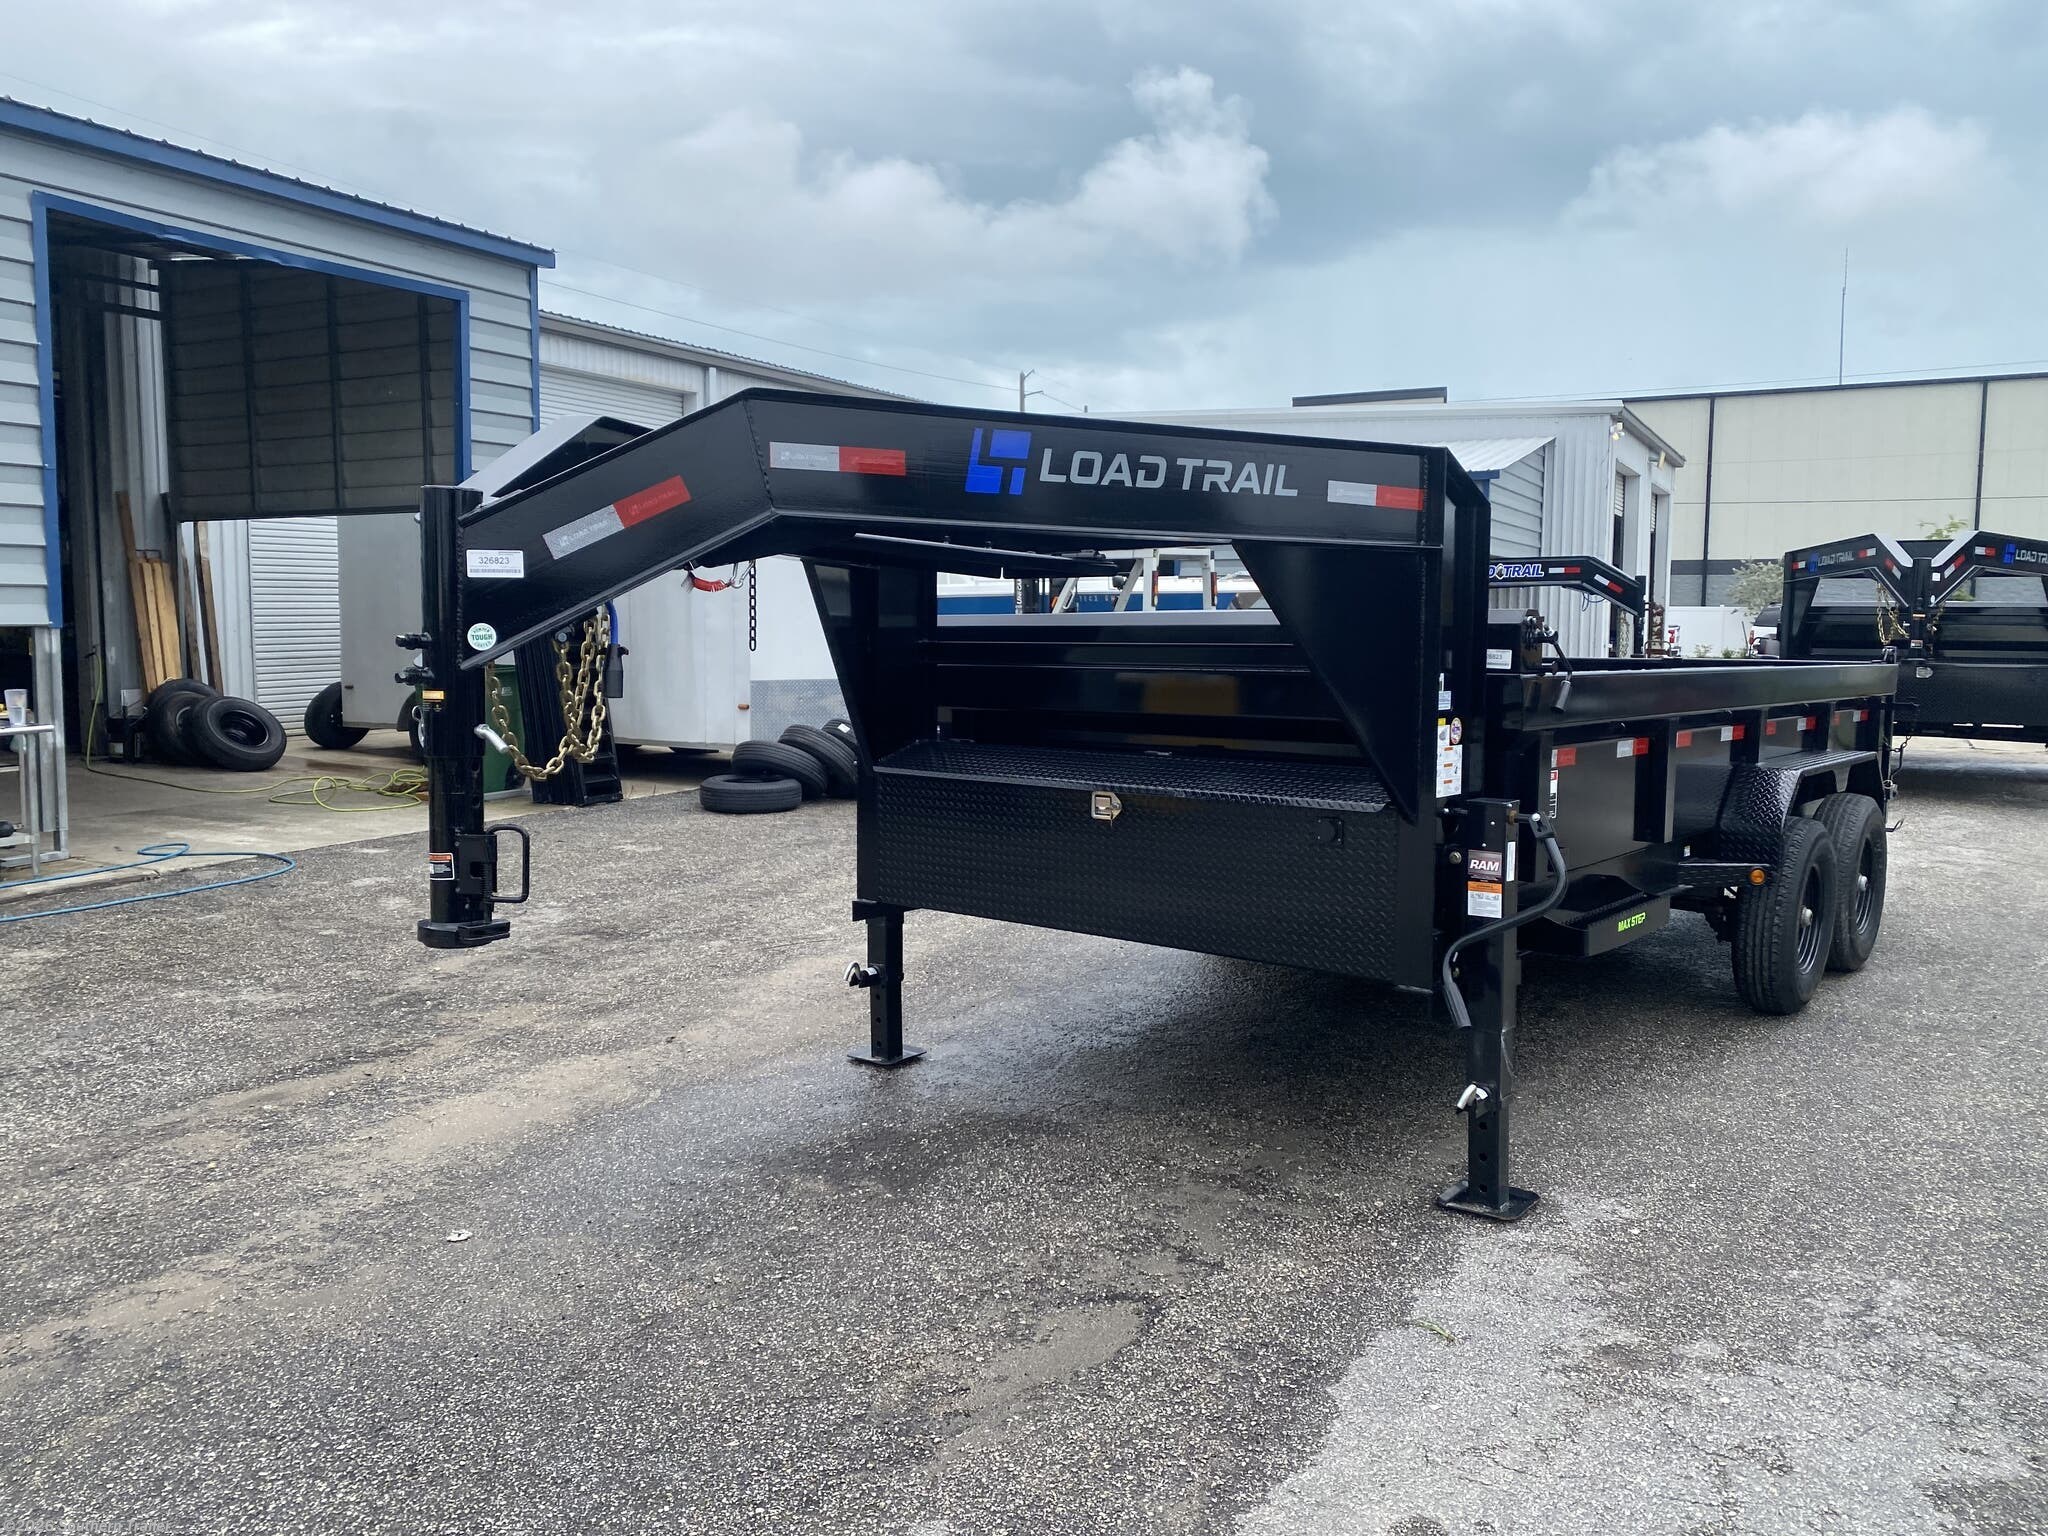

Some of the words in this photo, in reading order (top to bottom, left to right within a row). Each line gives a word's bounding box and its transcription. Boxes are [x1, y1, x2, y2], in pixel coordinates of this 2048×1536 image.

[1039, 447, 1167, 489] LOAD
[1177, 457, 1299, 498] TRAIL
[478, 556, 510, 565] 326823
[2015, 549, 2037, 562] LOAD
[1503, 564, 1544, 578] TRAIL
[1469, 859, 1499, 871] RAM
[1618, 918, 1631, 932] MAX
[1631, 912, 1646, 927] STEP
